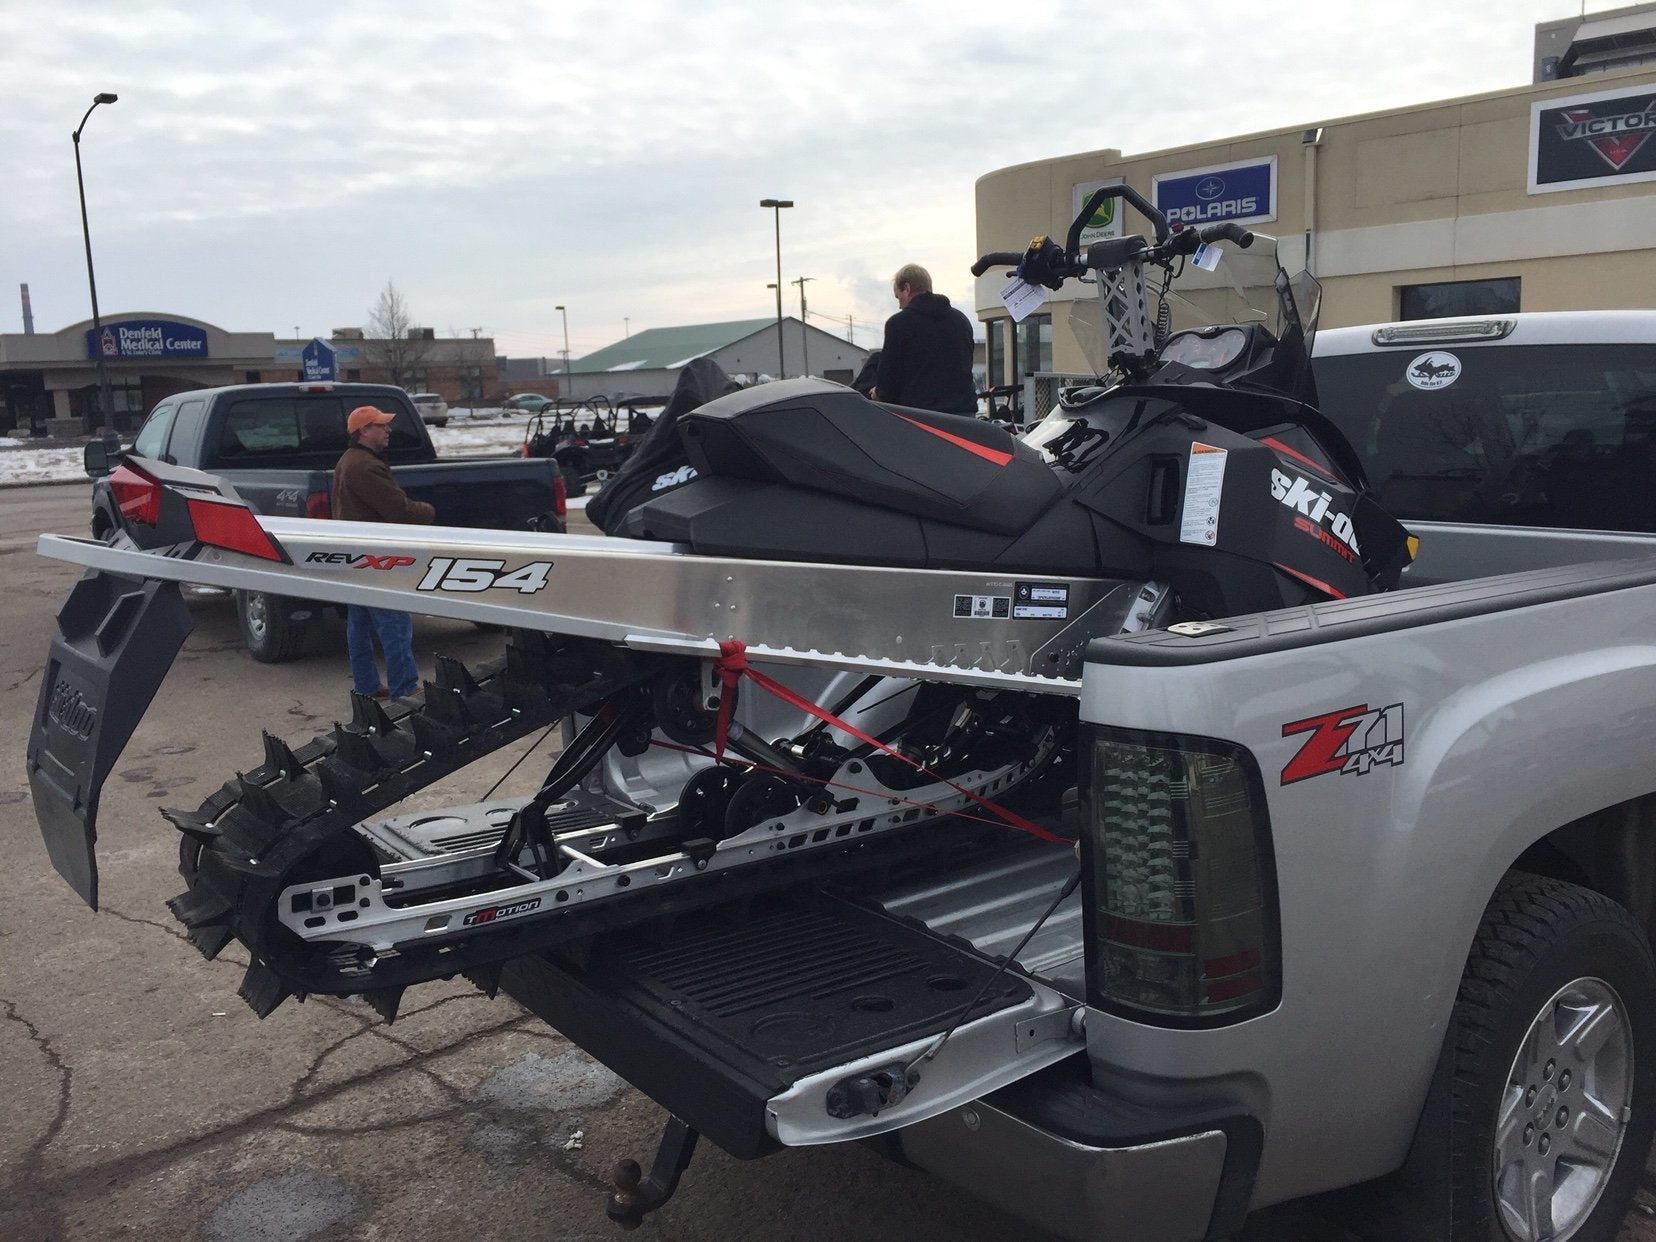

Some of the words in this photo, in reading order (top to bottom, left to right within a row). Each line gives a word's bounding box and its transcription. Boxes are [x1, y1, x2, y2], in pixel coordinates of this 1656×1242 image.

[1166, 197, 1257, 223] POLARIS
[119, 326, 162, 339] Denfeld
[120, 338, 164, 351] Medical
[166, 338, 202, 350] Center
[1294, 516, 1356, 563] SUMMIT
[416, 556, 554, 594] 154
[1280, 702, 1404, 786] Z71
